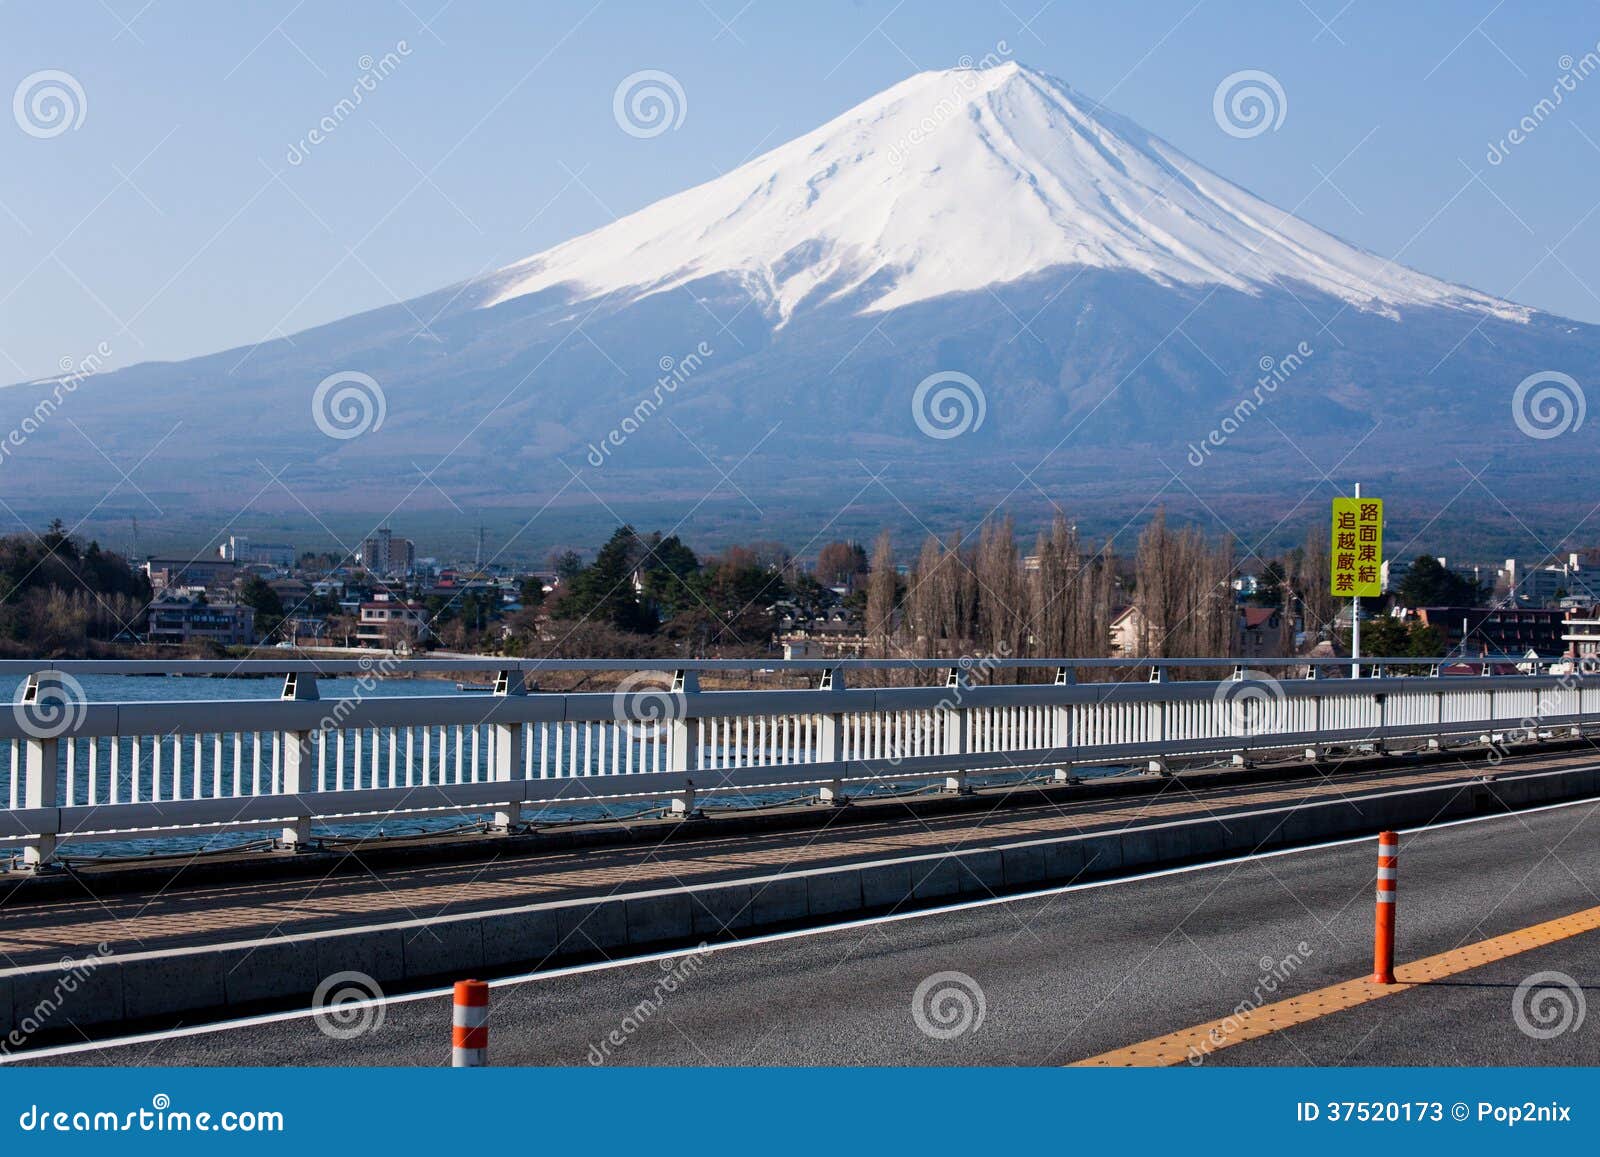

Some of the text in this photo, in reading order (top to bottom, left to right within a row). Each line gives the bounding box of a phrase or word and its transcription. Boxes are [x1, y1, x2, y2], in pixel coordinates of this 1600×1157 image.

[1336, 511, 1356, 591] 追越厳禁
[1358, 503, 1378, 583] 路面凍結
